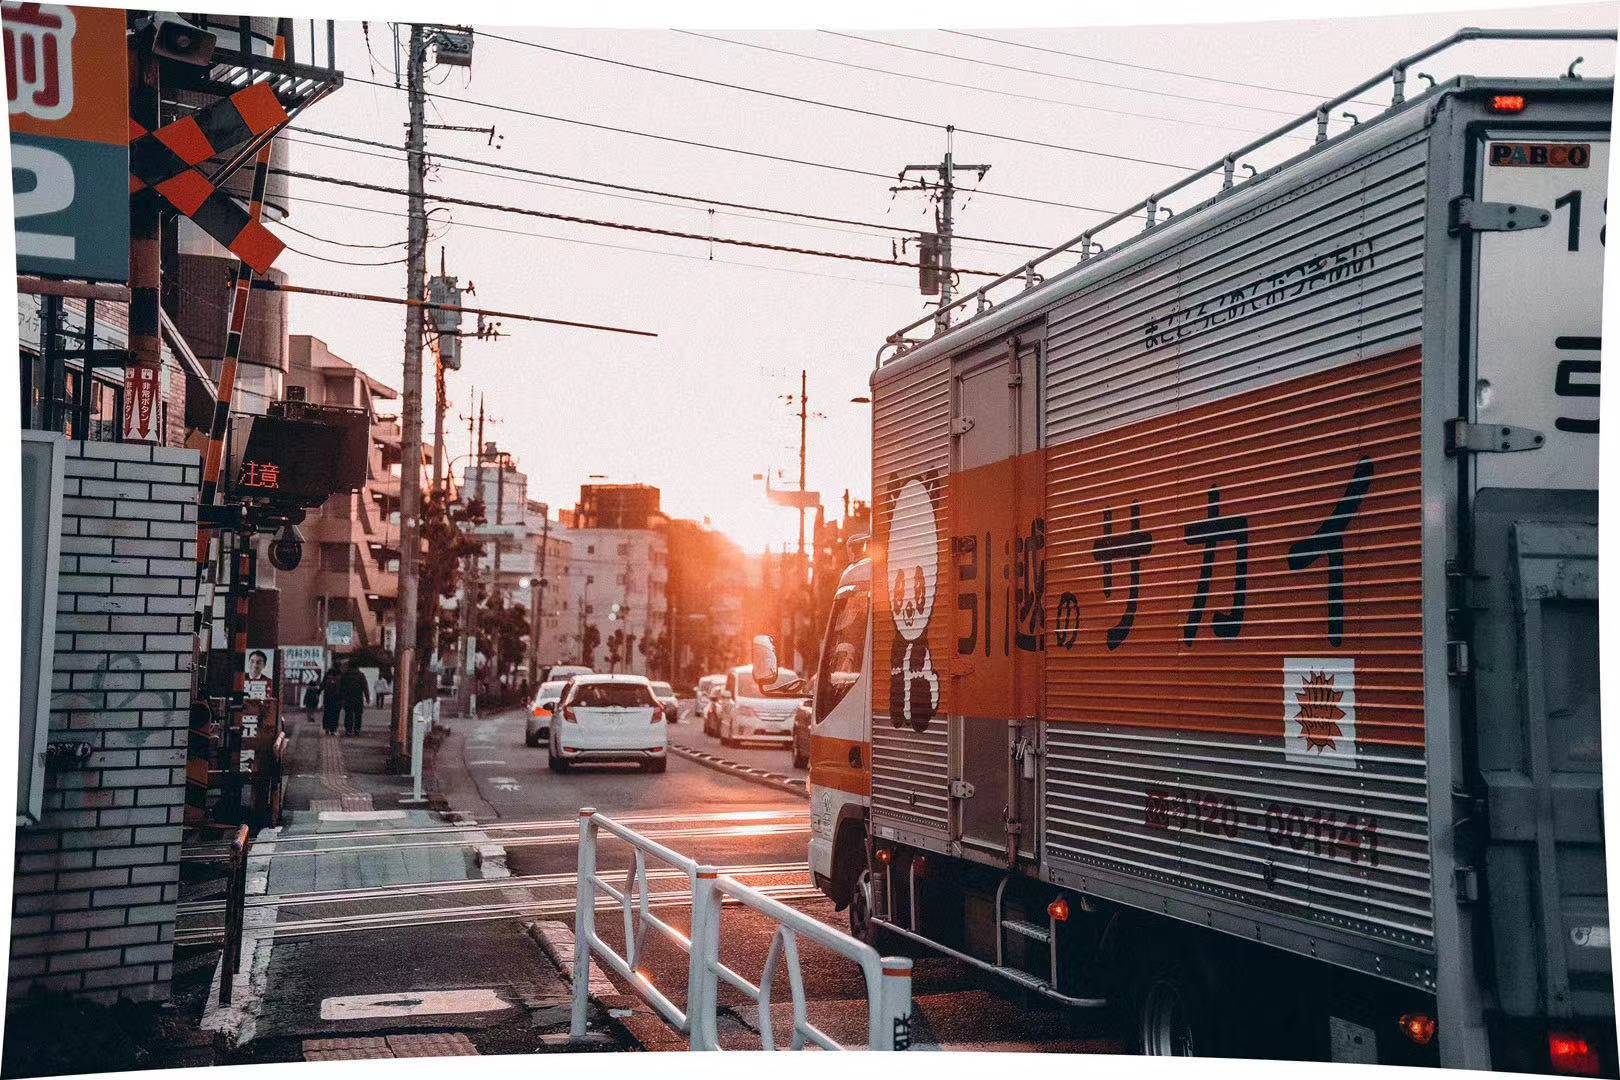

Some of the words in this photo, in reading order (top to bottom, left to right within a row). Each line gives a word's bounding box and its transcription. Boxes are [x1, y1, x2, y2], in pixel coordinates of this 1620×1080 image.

[1492, 144, 1589, 166] PABCO
[141, 382, 152, 421] 非常ボタン
[238, 460, 280, 489] 注意
